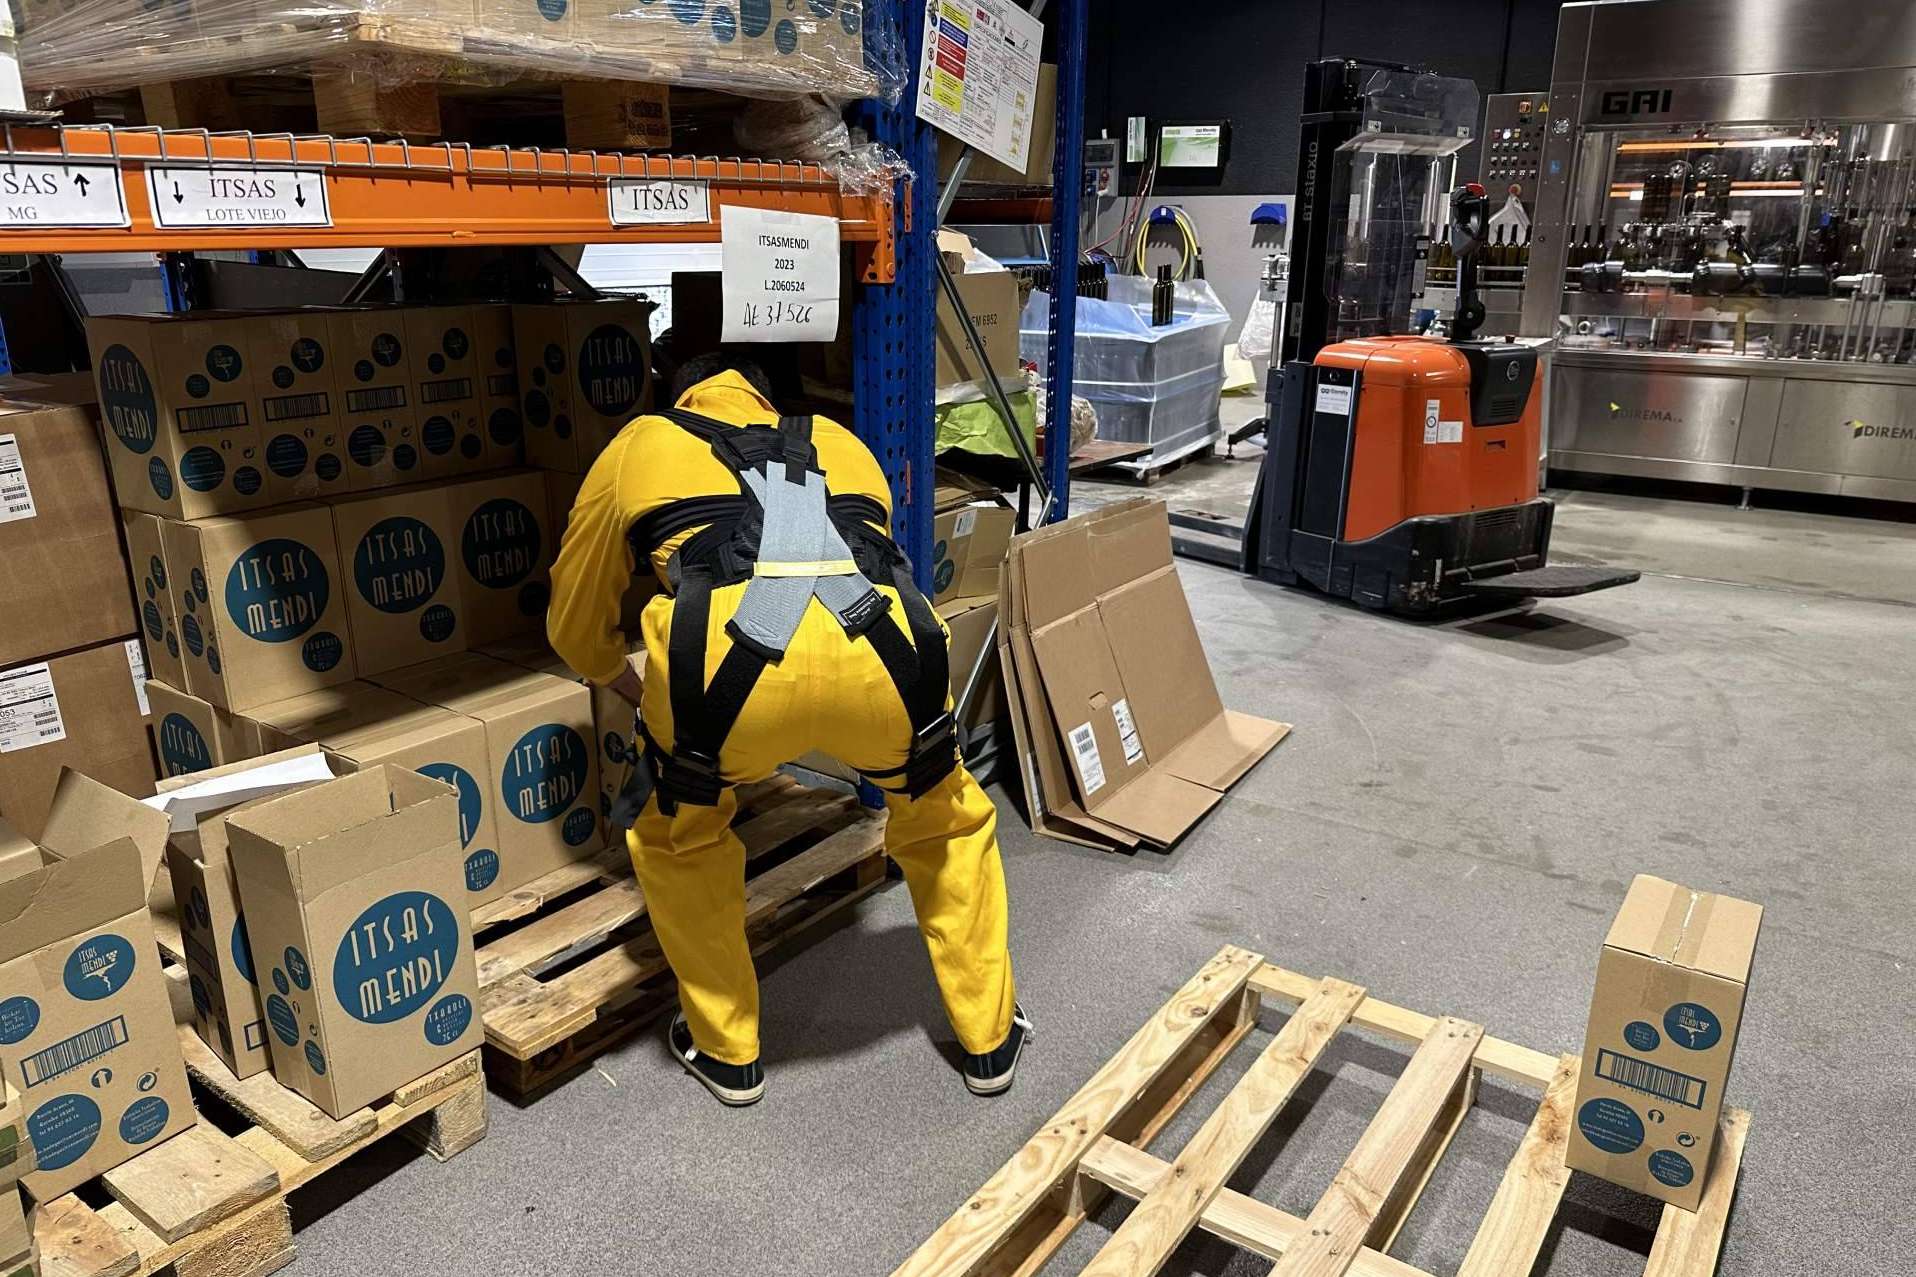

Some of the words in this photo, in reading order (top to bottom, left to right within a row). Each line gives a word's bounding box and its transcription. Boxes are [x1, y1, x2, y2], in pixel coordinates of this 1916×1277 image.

[1602, 89, 1673, 115] GAI
[3, 173, 58, 195] SAS
[209, 178, 277, 199] ITSAS
[632, 188, 690, 211] ITSAS
[8, 206, 37, 220] MG
[207, 208, 245, 221] LOTE
[247, 208, 286, 221] VIEJO
[758, 235, 809, 249] ITSASMENDI
[774, 258, 795, 270] 2023
[764, 280, 805, 292] L.2060524
[587, 335, 632, 367] ITSAS
[103, 359, 145, 394] ITSAS
[591, 375, 636, 405] MENDI
[113, 405, 153, 442] MENDI
[1864, 425, 1916, 440] DIREM
[473, 509, 526, 542] ITSAS
[365, 527, 427, 565] ITSAS
[238, 549, 309, 591] ITSAS
[477, 546, 530, 580] MENDI
[372, 567, 434, 606] MENDI
[247, 592, 317, 634] MENDI
[165, 720, 202, 761] ITSAS
[514, 732, 572, 777] ITSAS
[519, 771, 576, 817] MENDI
[350, 899, 434, 966] ITSAS
[78, 946, 98, 963] ITSAS
[81, 957, 107, 974] MENDI
[359, 949, 443, 1019] MENDI
